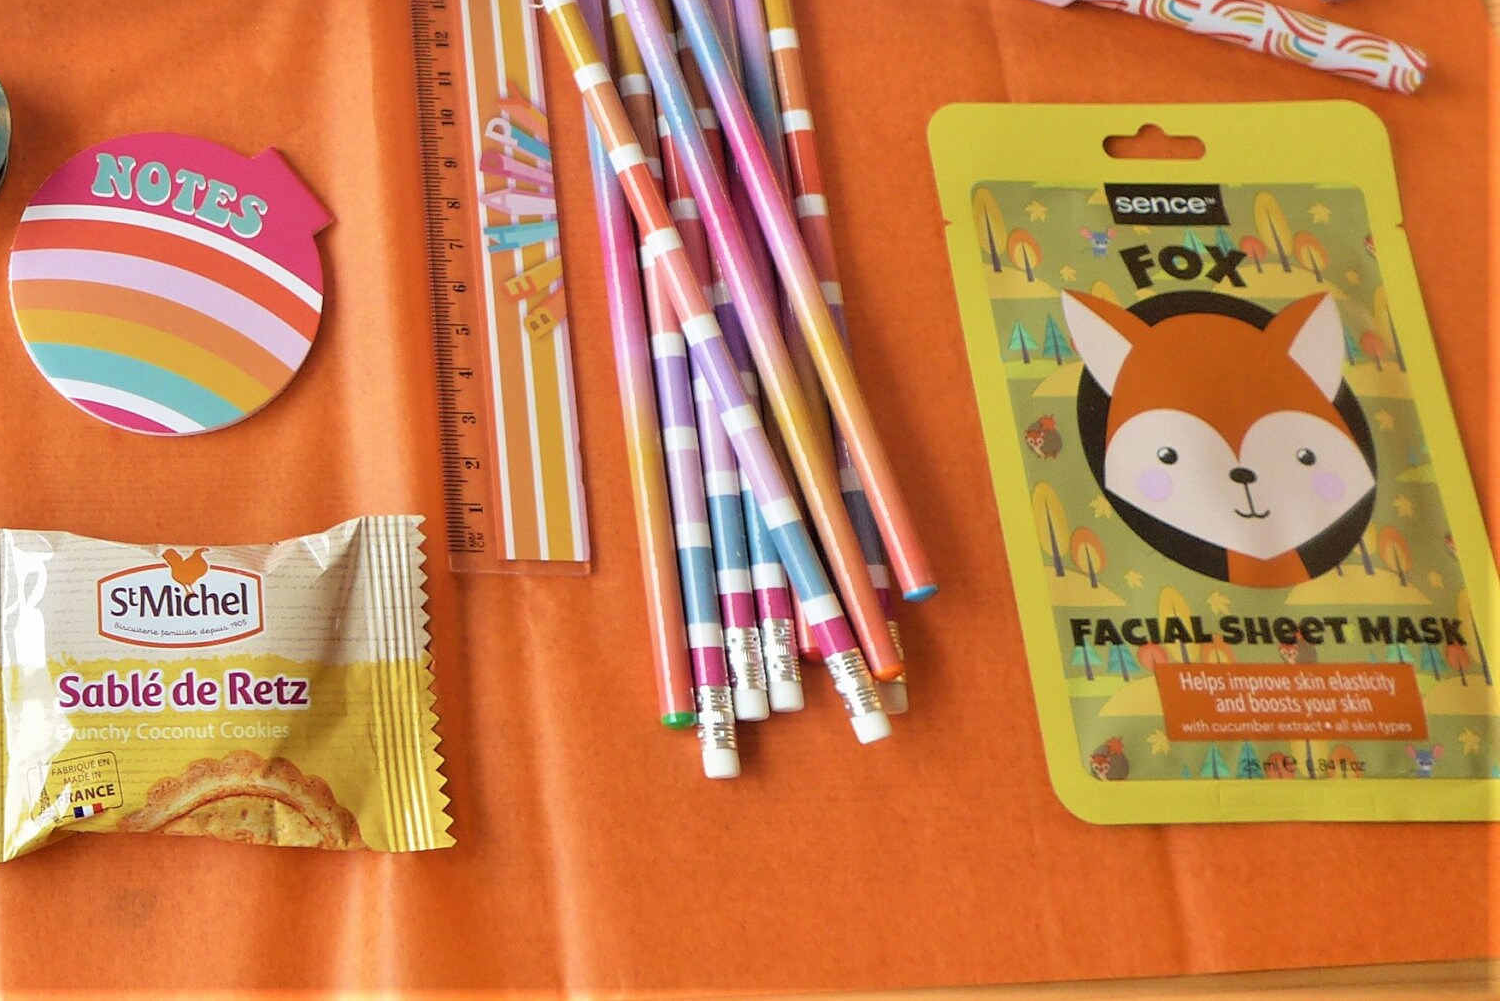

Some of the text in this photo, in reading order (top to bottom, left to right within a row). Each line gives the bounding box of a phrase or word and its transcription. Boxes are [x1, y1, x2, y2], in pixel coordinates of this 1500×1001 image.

[435, 30, 450, 49] 12
[438, 69, 452, 88] 11
[440, 108, 455, 127] 10
[444, 158, 458, 169] 9
[92, 152, 268, 239] NOTES
[447, 199, 461, 209] 8
[1119, 244, 1247, 290] FOX
[452, 284, 467, 294] 6
[456, 326, 471, 337] 5
[459, 369, 474, 380] 4
[462, 414, 477, 425] 3
[465, 459, 481, 470] 2
[468, 505, 484, 515] 1
[200, 625, 229, 636] depuis
[1070, 615, 1213, 646] FACIAL
[1359, 615, 1467, 645] MASK
[58, 671, 308, 709] Sablé de Retz
[1180, 672, 1396, 696] Helps improve skin elasticity
[1216, 696, 1372, 718] and boosts your skin
[137, 723, 215, 740] Coconut
[220, 721, 290, 739] Cookies
[1182, 720, 1412, 735] with cucumber extract all skin types
[97, 758, 111, 767] EN
[63, 771, 102, 785] MADE IN
